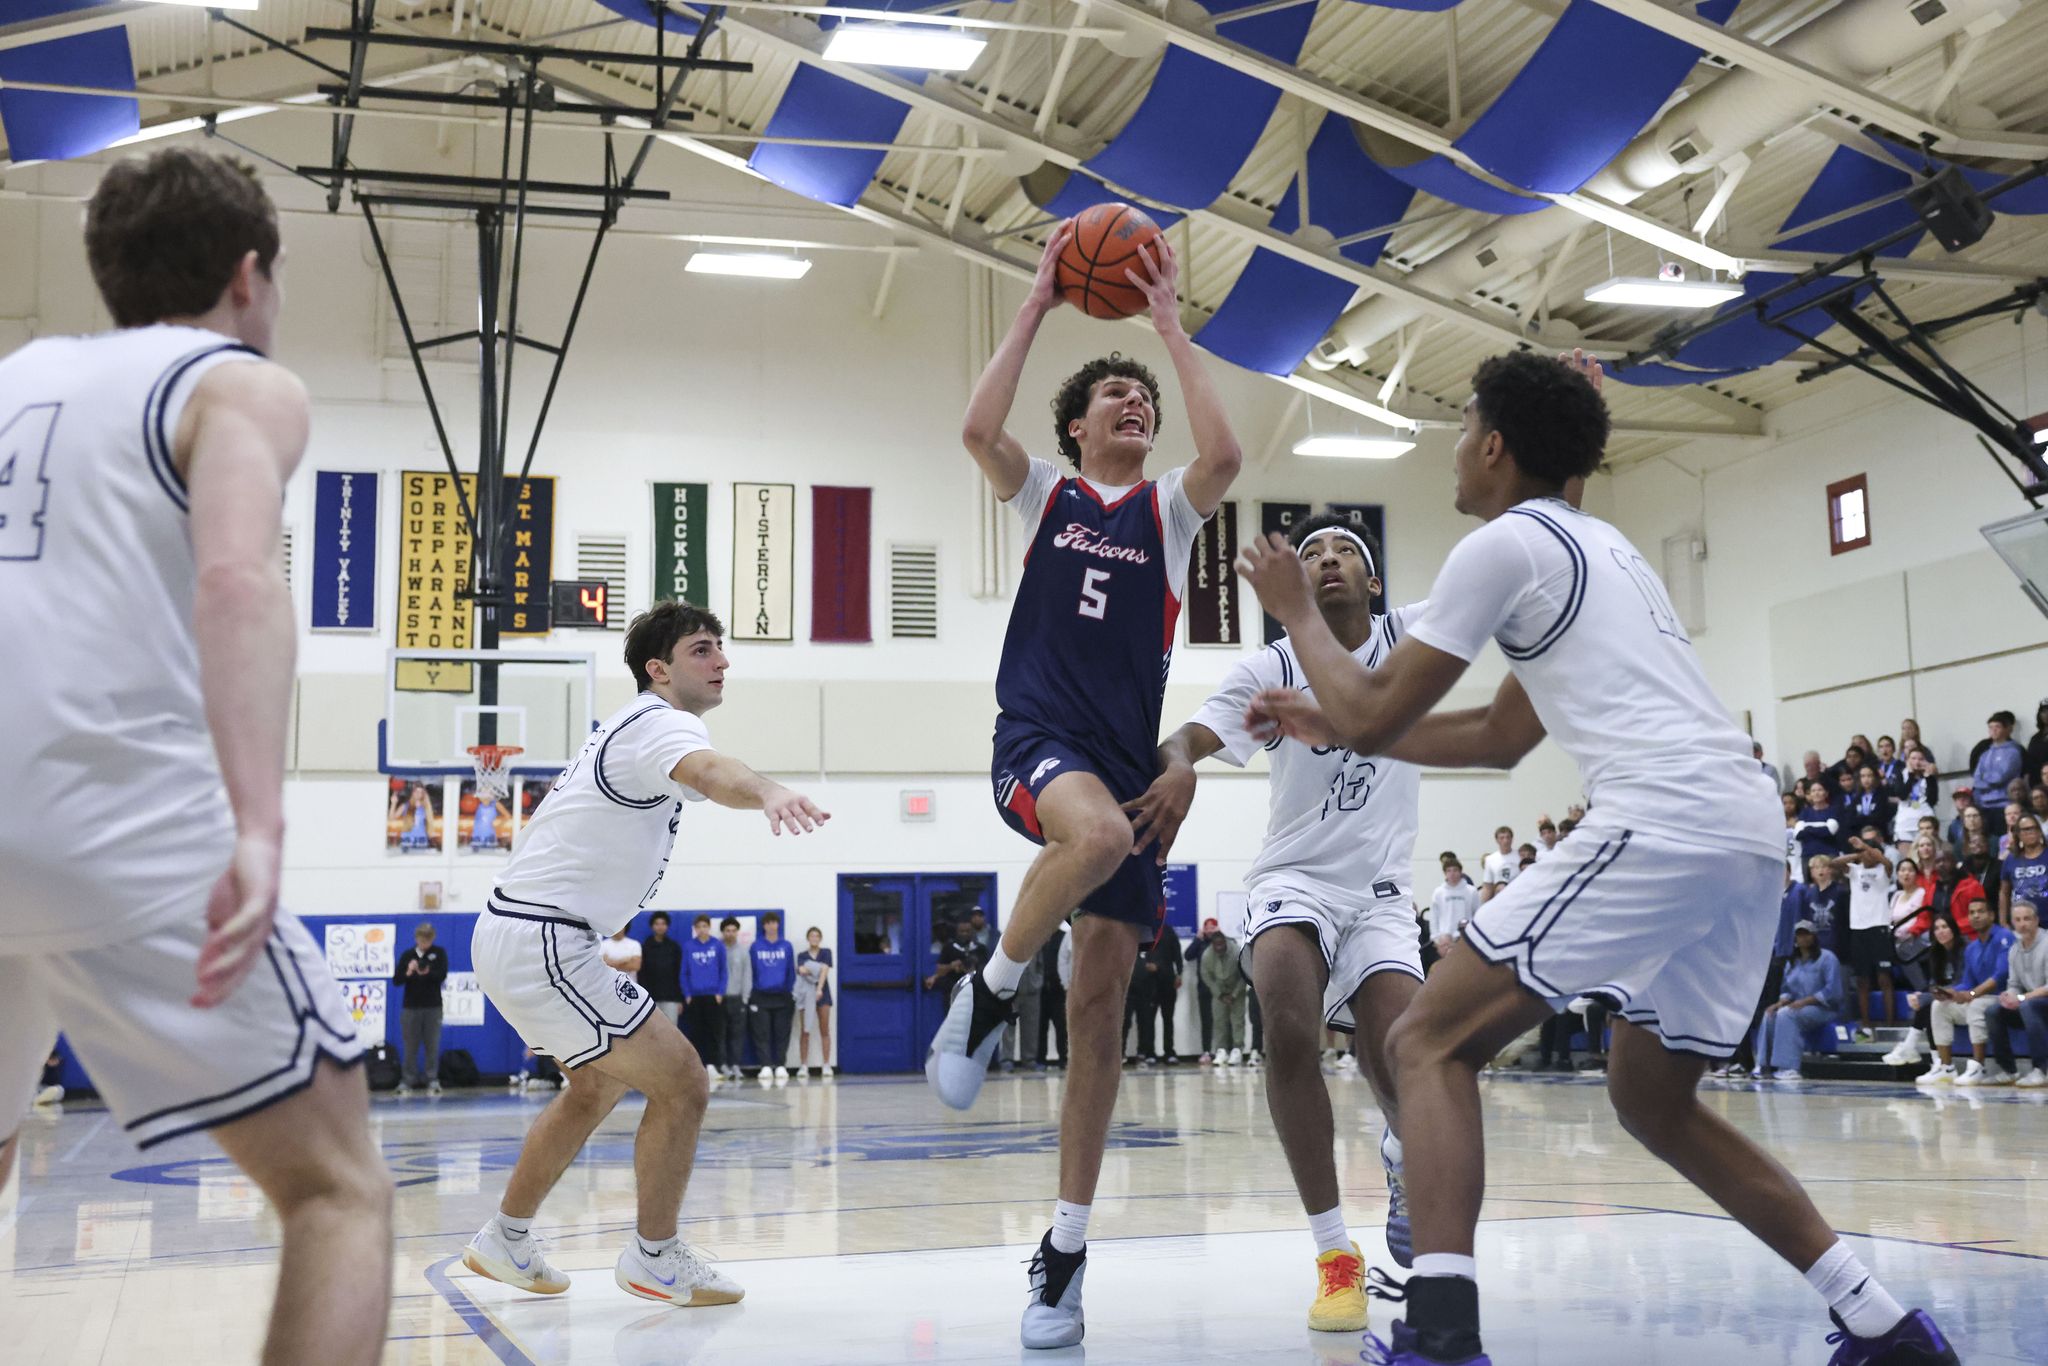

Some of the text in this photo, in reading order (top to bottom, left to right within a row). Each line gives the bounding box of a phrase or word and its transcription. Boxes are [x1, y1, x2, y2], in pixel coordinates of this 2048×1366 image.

[337, 474, 353, 626] TRINITY VALLEY
[405, 477, 424, 648] SOUTHWEST
[426, 477, 447, 686] PREPARATOY
[452, 478, 470, 667] CONFERENC
[757, 488, 769, 635] CISTERCIAN
[1053, 522, 1149, 564] Falcons
[1078, 567, 1111, 620] 5
[1218, 562, 1228, 583] OF
[580, 586, 604, 623] 4
[1218, 584, 1230, 642] DALLAS
